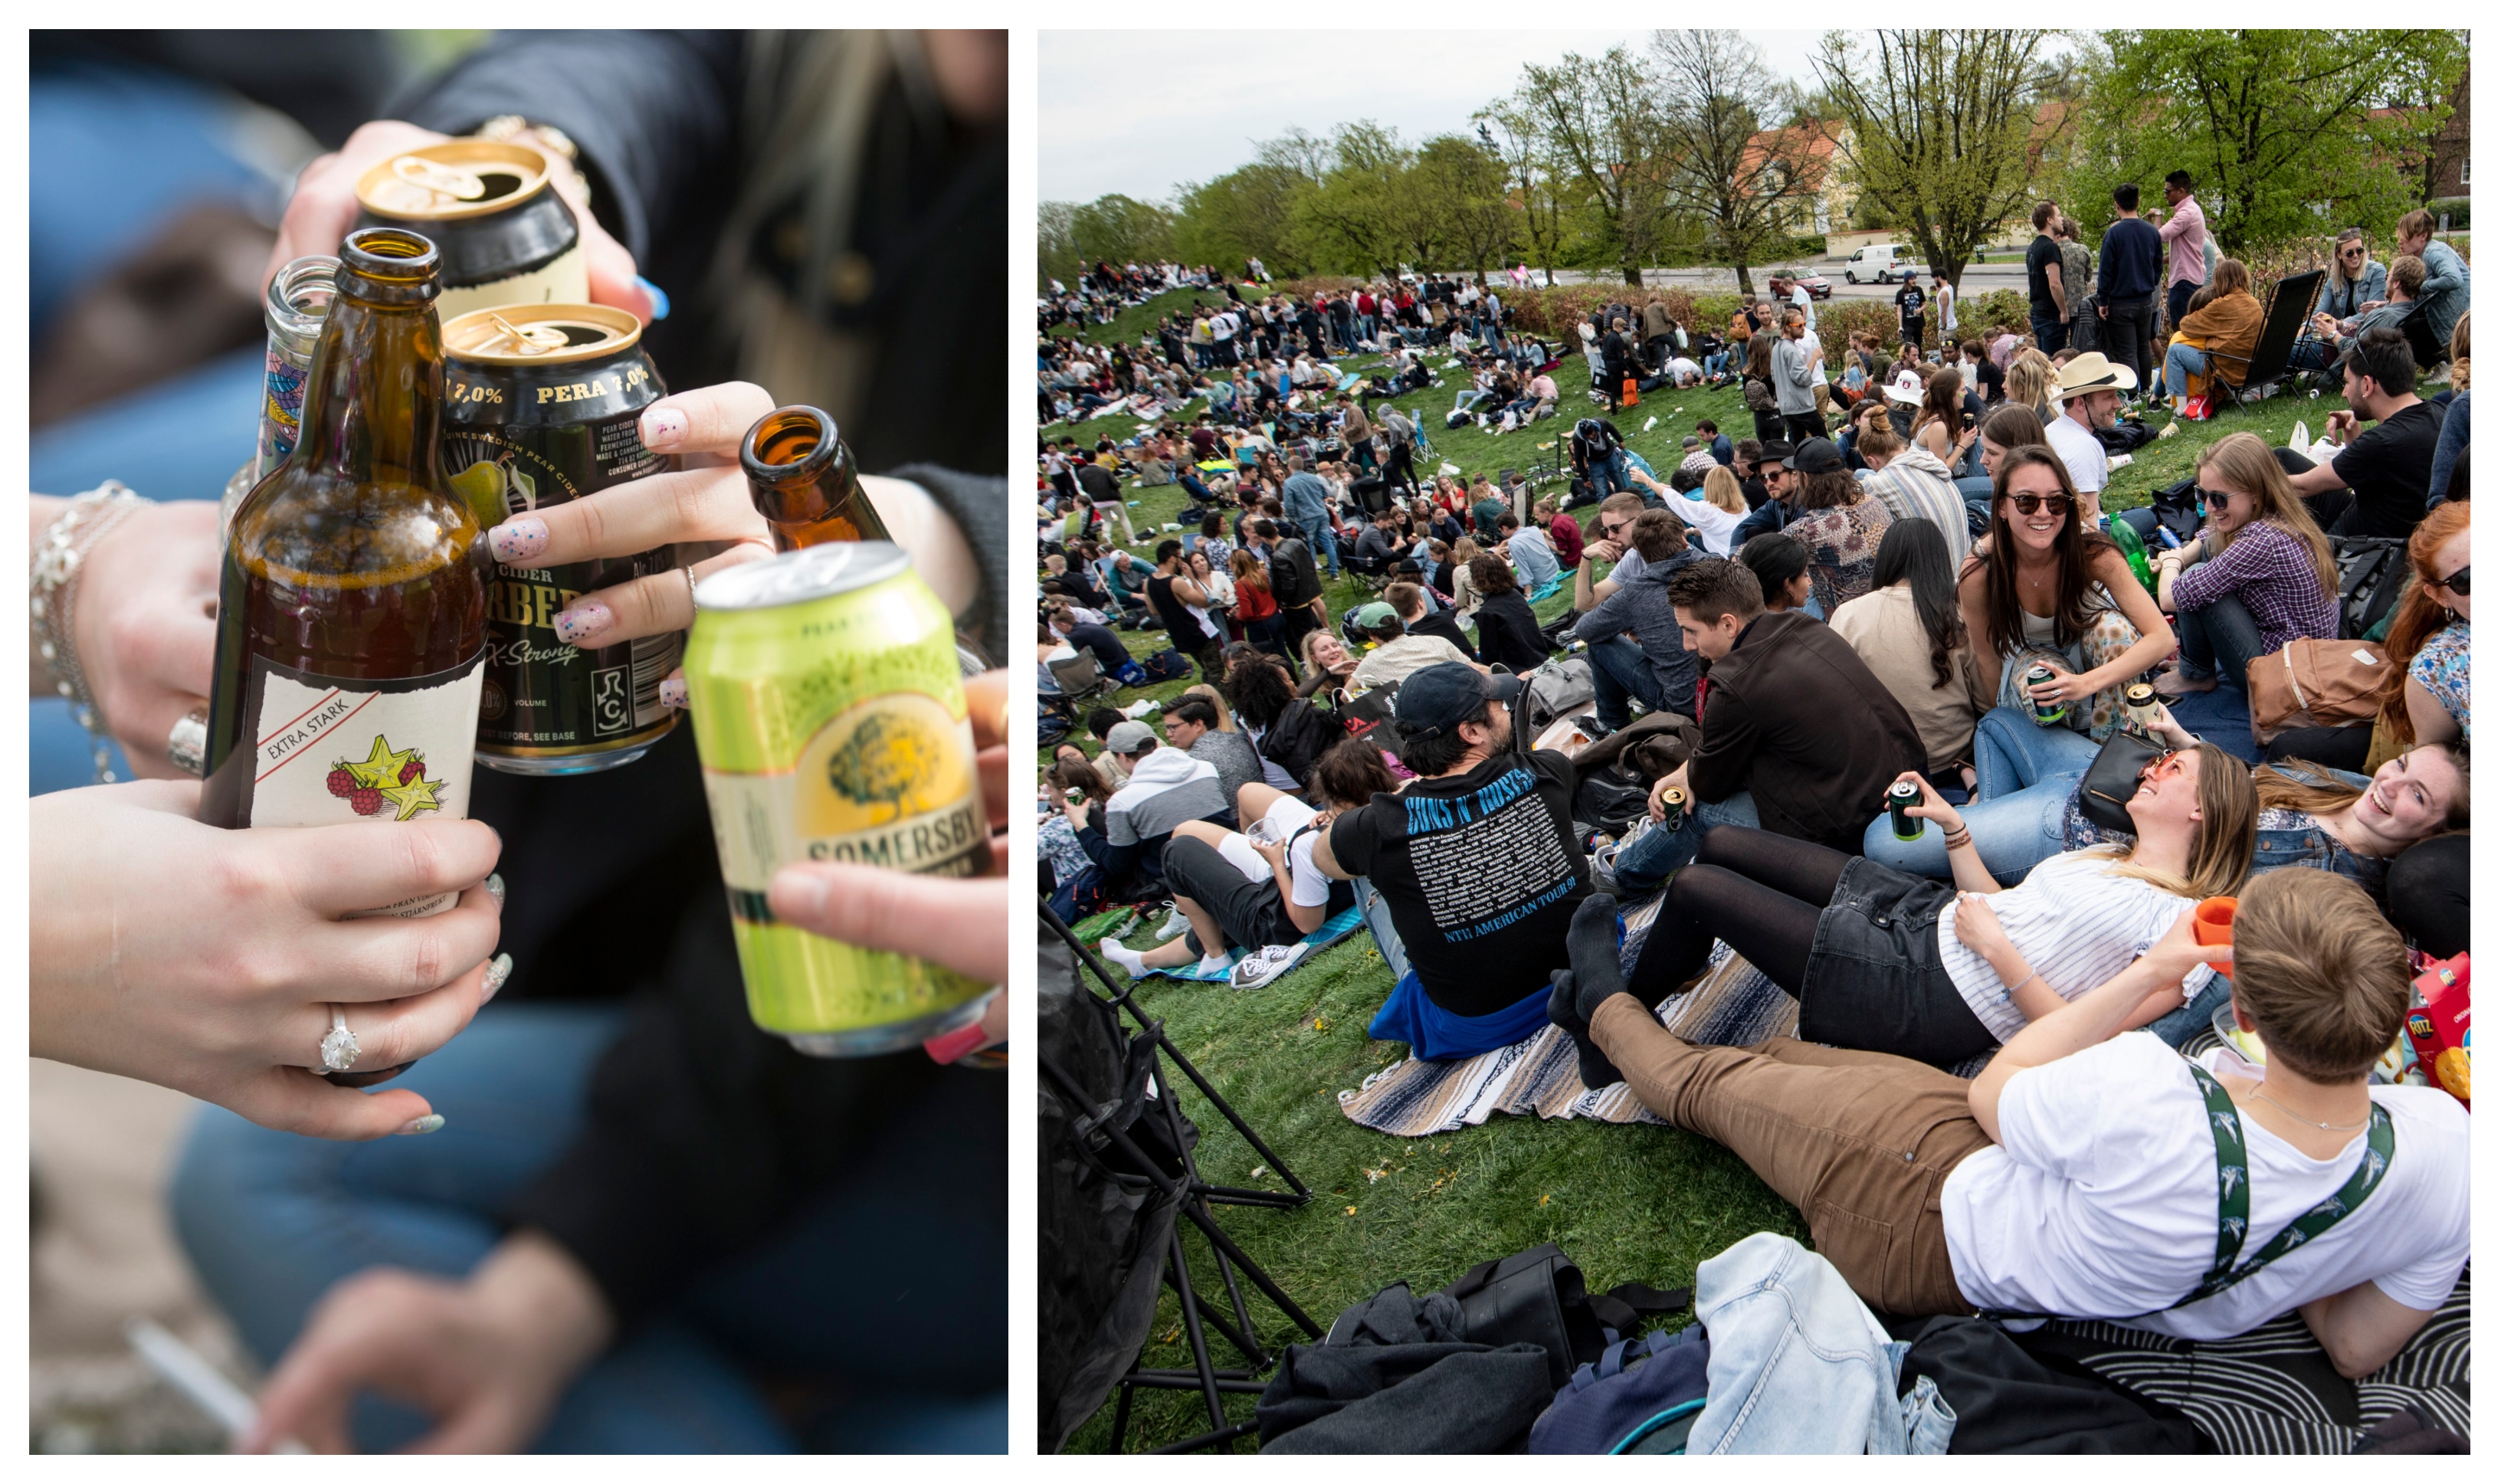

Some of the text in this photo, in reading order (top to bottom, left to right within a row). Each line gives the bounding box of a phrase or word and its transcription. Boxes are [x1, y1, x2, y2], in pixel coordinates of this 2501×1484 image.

[537, 365, 649, 404] PERA 7,0%
[454, 383, 503, 404] 7,0%
[601, 428, 636, 443] WATER FROM
[602, 424, 618, 434] PEAR
[618, 420, 634, 430] CIDER
[471, 433, 523, 454] SWEDISH
[526, 450, 556, 473] PEAR
[596, 451, 612, 461] MADE
[619, 444, 640, 456] CANNED
[601, 437, 632, 452] FERMENTED
[608, 462, 637, 476] CONSUMER
[498, 565, 552, 583] CIDER
[267, 699, 349, 760] EXTRA STARK
[498, 730, 533, 742] BEFORE,
[534, 732, 550, 741] SEE
[552, 732, 575, 740] BASE
[1405, 797, 1454, 835] GUNS
[1474, 899, 1538, 937] AMERICAN
[1537, 883, 1568, 907] TOUR
[1567, 876, 1576, 890] 91
[2408, 1019, 2434, 1035] RITZ
